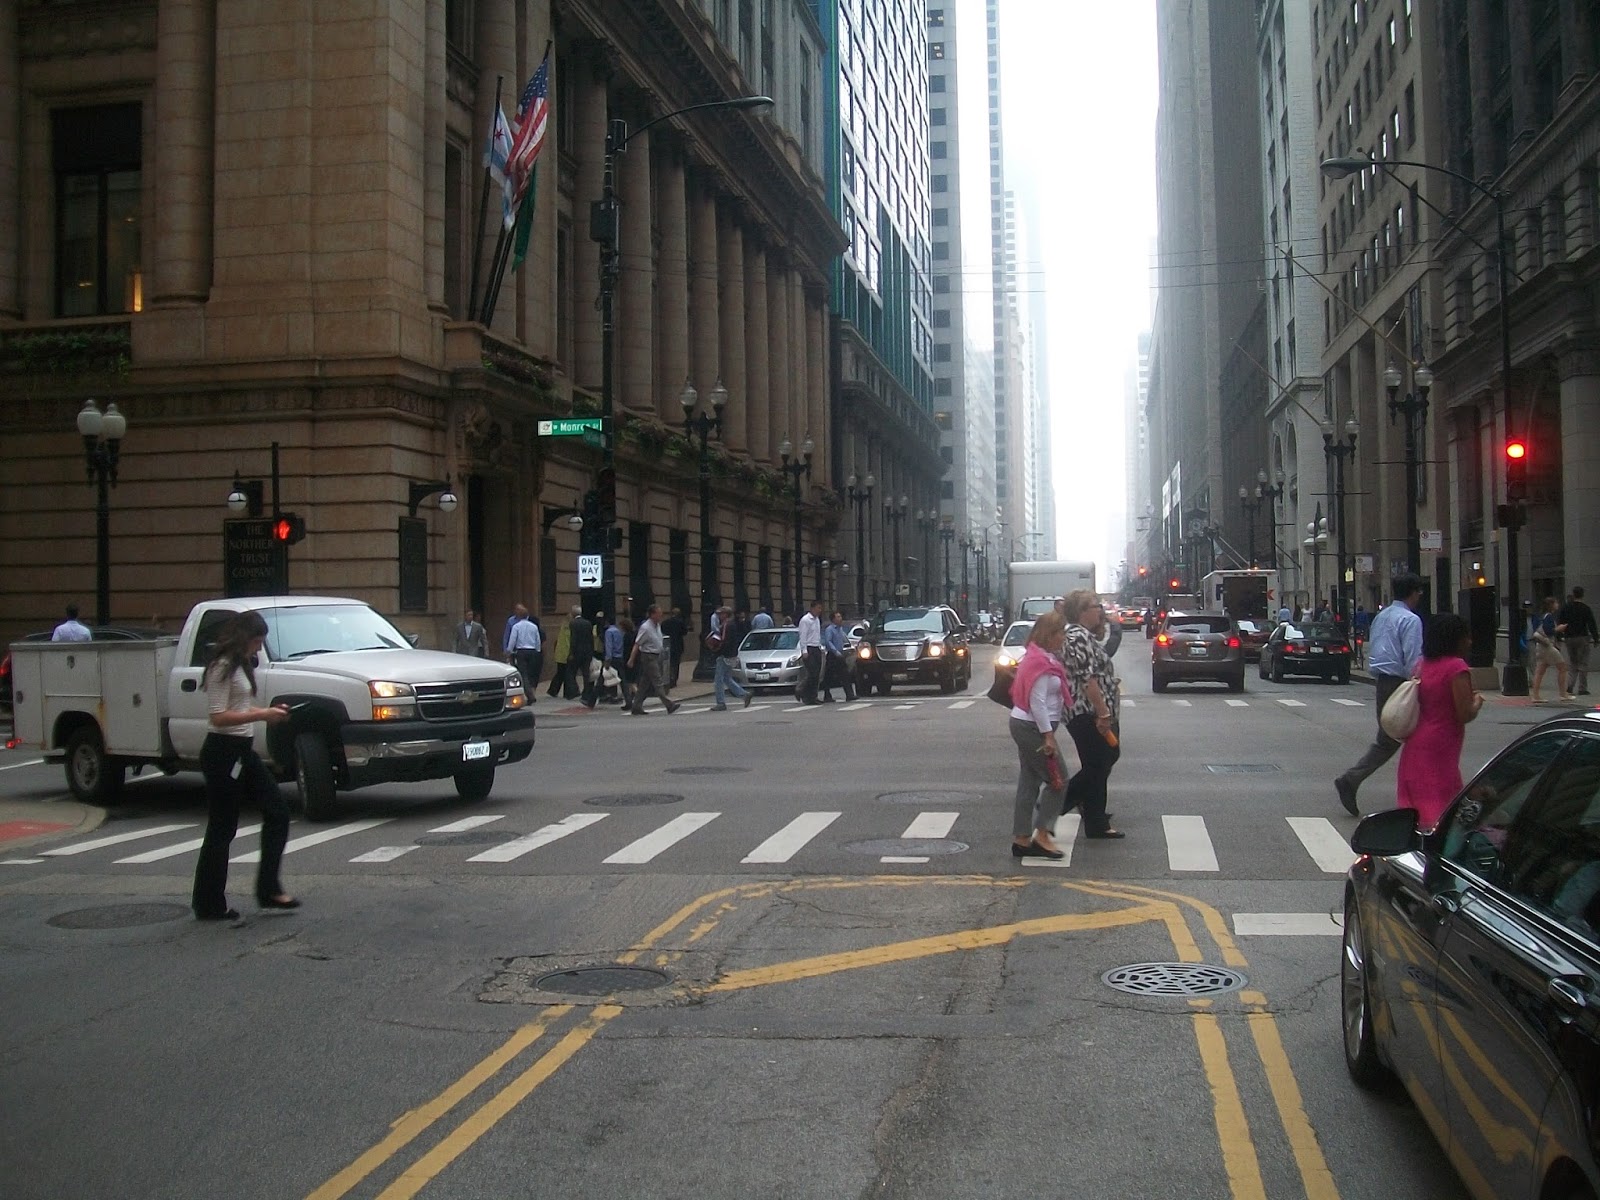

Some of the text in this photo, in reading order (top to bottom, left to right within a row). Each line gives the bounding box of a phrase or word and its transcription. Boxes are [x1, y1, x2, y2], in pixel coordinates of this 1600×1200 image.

[245, 524, 264, 535] THE
[229, 538, 275, 550] NORTHER
[240, 553, 269, 564] TRUST
[581, 557, 599, 565] ONE
[581, 566, 599, 574] WAY
